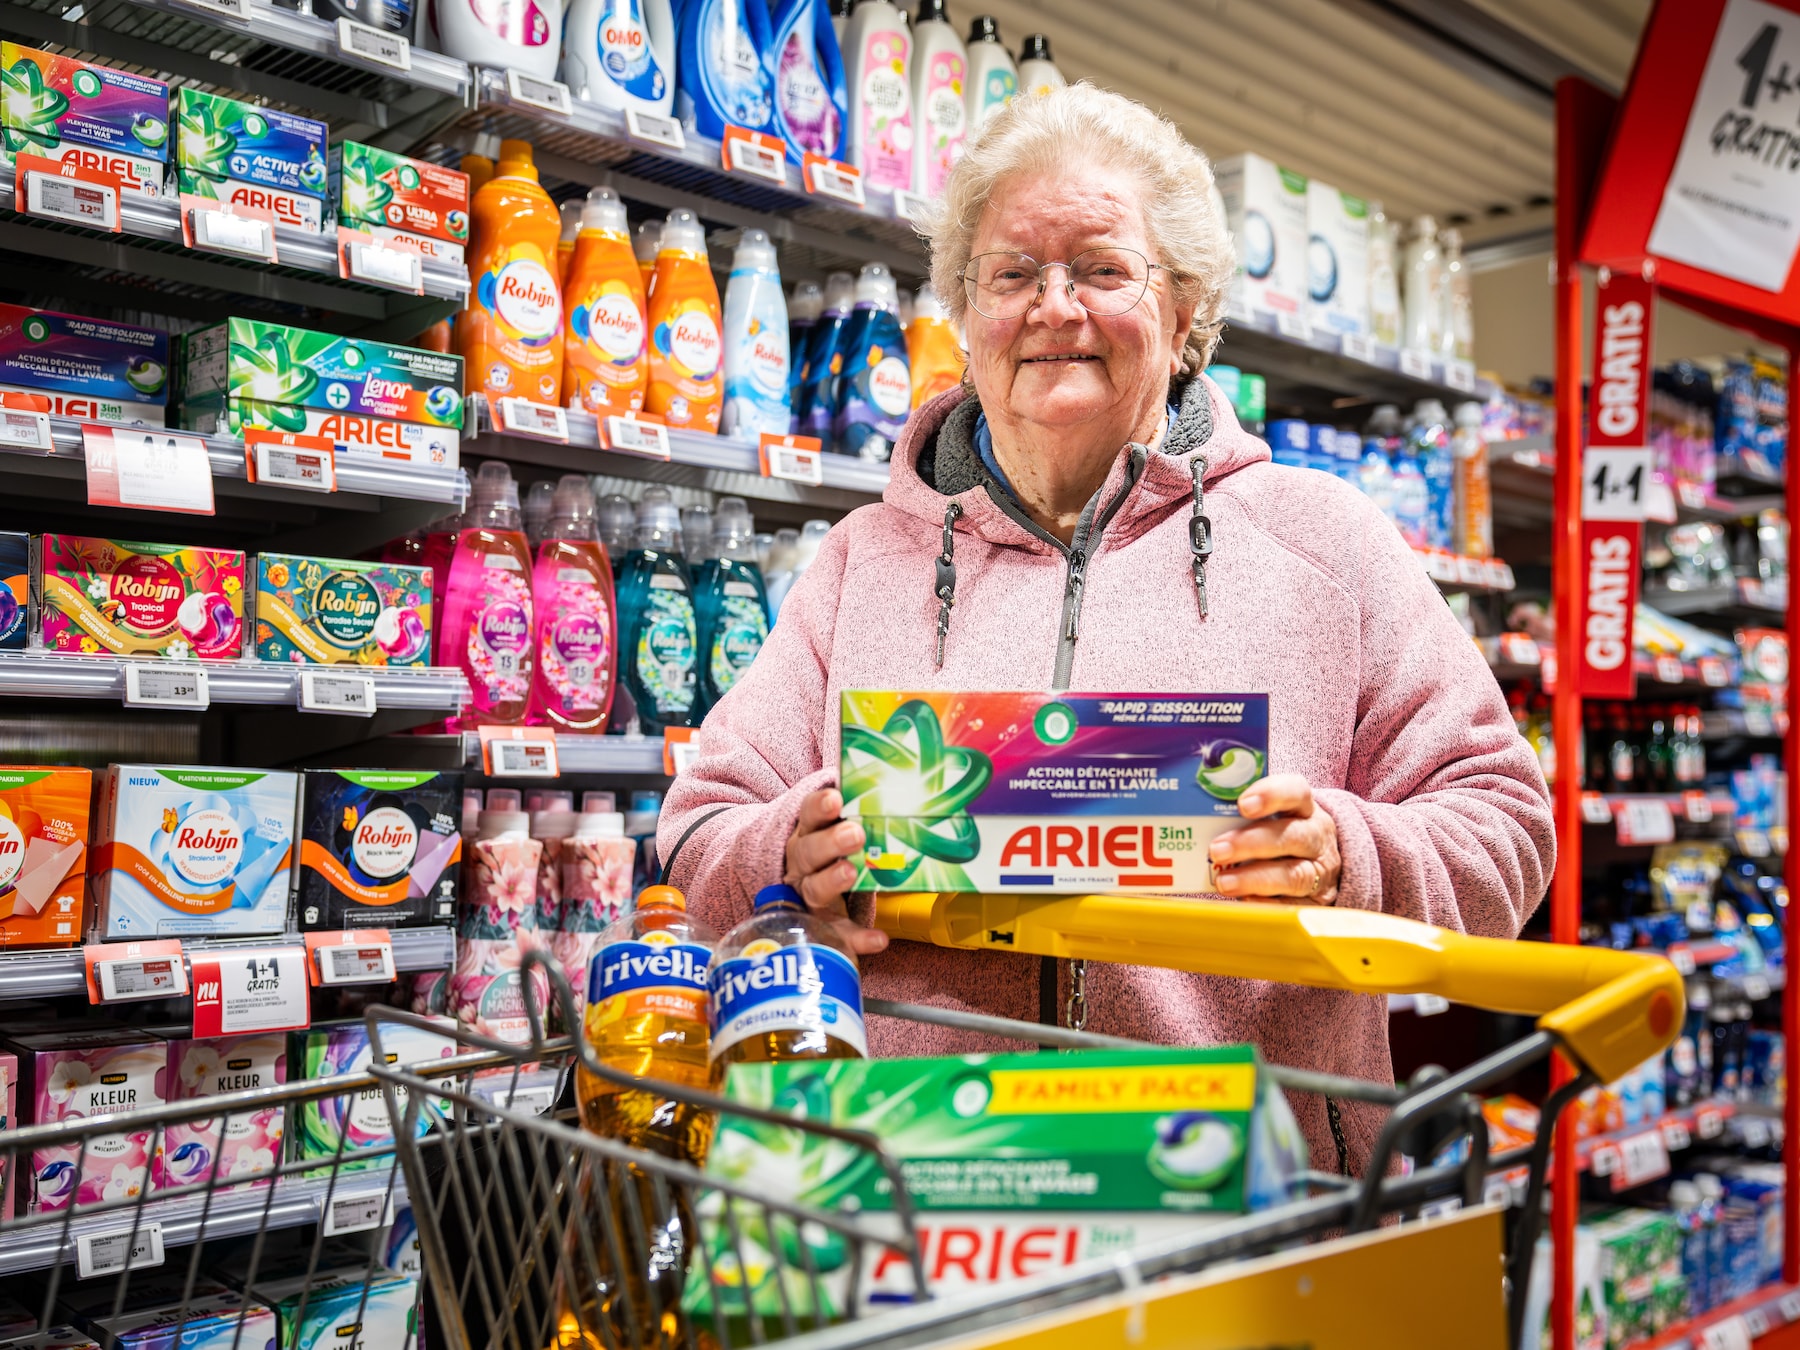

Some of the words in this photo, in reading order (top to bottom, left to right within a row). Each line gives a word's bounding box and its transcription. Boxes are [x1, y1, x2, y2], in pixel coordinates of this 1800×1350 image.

[606, 30, 641, 47] OMO
[103, 72, 123, 82] RAPID
[124, 76, 162, 91] DISSOLUTION
[66, 118, 124, 136] VLEKVERWIJDERING
[93, 130, 111, 139] WAS
[61, 149, 141, 182] ARIEL
[135, 164, 151, 173] 3in1
[252, 155, 299, 175] ACTIVE
[231, 188, 301, 218] ARIEL
[406, 205, 438, 222] ULTRA
[502, 276, 555, 307] Robijn
[595, 308, 639, 333] Robijn
[67, 321, 95, 331] RAPID
[98, 326, 156, 341] DISSOLUTION
[676, 326, 716, 349] Robijn
[6, 360, 57, 373] IMPECCABLE
[59, 367, 69, 375] EN
[77, 370, 115, 382] LAVAGE
[18, 354, 49, 364] ACTION
[50, 358, 101, 371] DÉTACHANTE
[1598, 301, 1646, 437] GRATIS
[362, 372, 412, 399] Lenor
[100, 403, 122, 413] 3in1
[318, 415, 411, 449] ARIEL
[404, 426, 423, 434] 4in1
[431, 450, 443, 462] 26
[114, 574, 180, 602] Robijn
[131, 602, 164, 613] Tropical
[319, 589, 377, 617] Robijn
[1584, 535, 1631, 671] GRATIS
[323, 615, 351, 625] Paradise
[353, 616, 374, 626] Secret
[485, 615, 526, 637] Robijn
[79, 613, 124, 649] GEURBELEVING
[558, 627, 602, 647] Robijn
[58, 638, 67, 646] 15
[501, 655, 512, 668] 15
[1102, 702, 1147, 715] RAPID
[1152, 702, 1244, 715] DISSOLUTION
[1113, 713, 1137, 723] MÊME
[1147, 715, 1173, 723] FROID
[1180, 715, 1206, 723] ZELFS
[1208, 715, 1216, 723] IN
[1218, 715, 1243, 723] KOUD
[177, 775, 212, 783] PLASTICVRIJE
[1027, 767, 1073, 778] ACTION
[1078, 765, 1157, 778] DÉTACHANTE
[129, 777, 160, 786] NIEUW
[1009, 779, 1086, 791] IMPECCABLE
[1090, 779, 1106, 791] EN
[1109, 778, 1115, 791] 1
[1120, 778, 1179, 791] LAVAGE
[51, 818, 74, 831] 100%
[263, 816, 283, 829] 100%
[177, 828, 238, 853] Robijn
[357, 825, 412, 847] Robijn
[1159, 826, 1193, 840] 3in1
[1000, 825, 1173, 867] ARIEL
[188, 854, 214, 862] Stralend
[179, 859, 235, 881] WASMIDDELDOEKJES
[134, 862, 150, 878] VOOR
[148, 872, 159, 885] EEN
[157, 881, 185, 904] STRALEND
[185, 897, 203, 907] WITTE
[246, 958, 279, 979] 1+1
[603, 949, 708, 987] rivella
[197, 982, 218, 1001] nu
[247, 978, 280, 993] GRATIS
[713, 955, 820, 1013] rivell
[645, 995, 697, 1011] PERZIK
[500, 1020, 528, 1030] COLOR
[734, 1008, 802, 1032] ORIGINA
[103, 1075, 126, 1083] JUMBO
[218, 1074, 260, 1091] KLEUR
[1012, 1076, 1128, 1101] FAMILY
[1138, 1073, 1231, 1098] PACK
[90, 1089, 137, 1106] KLEUR
[90, 1104, 137, 1116] ORCHIDEE
[94, 1144, 126, 1152] WASCAPSULES
